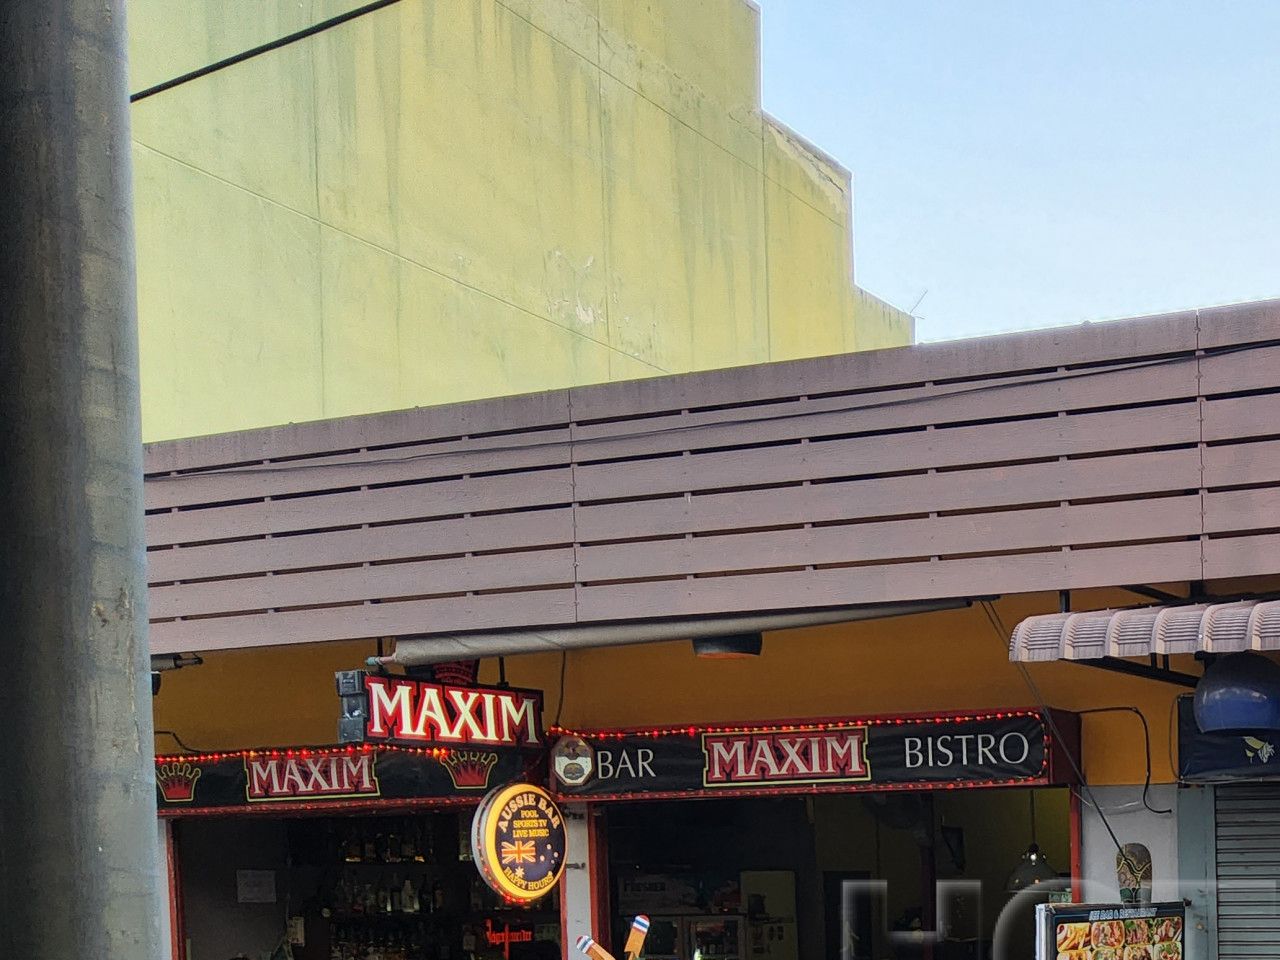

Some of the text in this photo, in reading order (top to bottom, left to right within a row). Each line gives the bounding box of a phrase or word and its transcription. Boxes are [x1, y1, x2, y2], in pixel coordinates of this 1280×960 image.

[369, 682, 539, 744] MAXIM
[596, 731, 1030, 780] BAR MAXIM BISTRO
[251, 755, 374, 794] MAXIM
[498, 793, 560, 834] AUSSIE BAR
[512, 819, 548, 828] SPORTS TV
[520, 809, 539, 818] POOL
[512, 828, 550, 838] LIVE MUSIC
[503, 866, 554, 890] HAPPY HOURS
